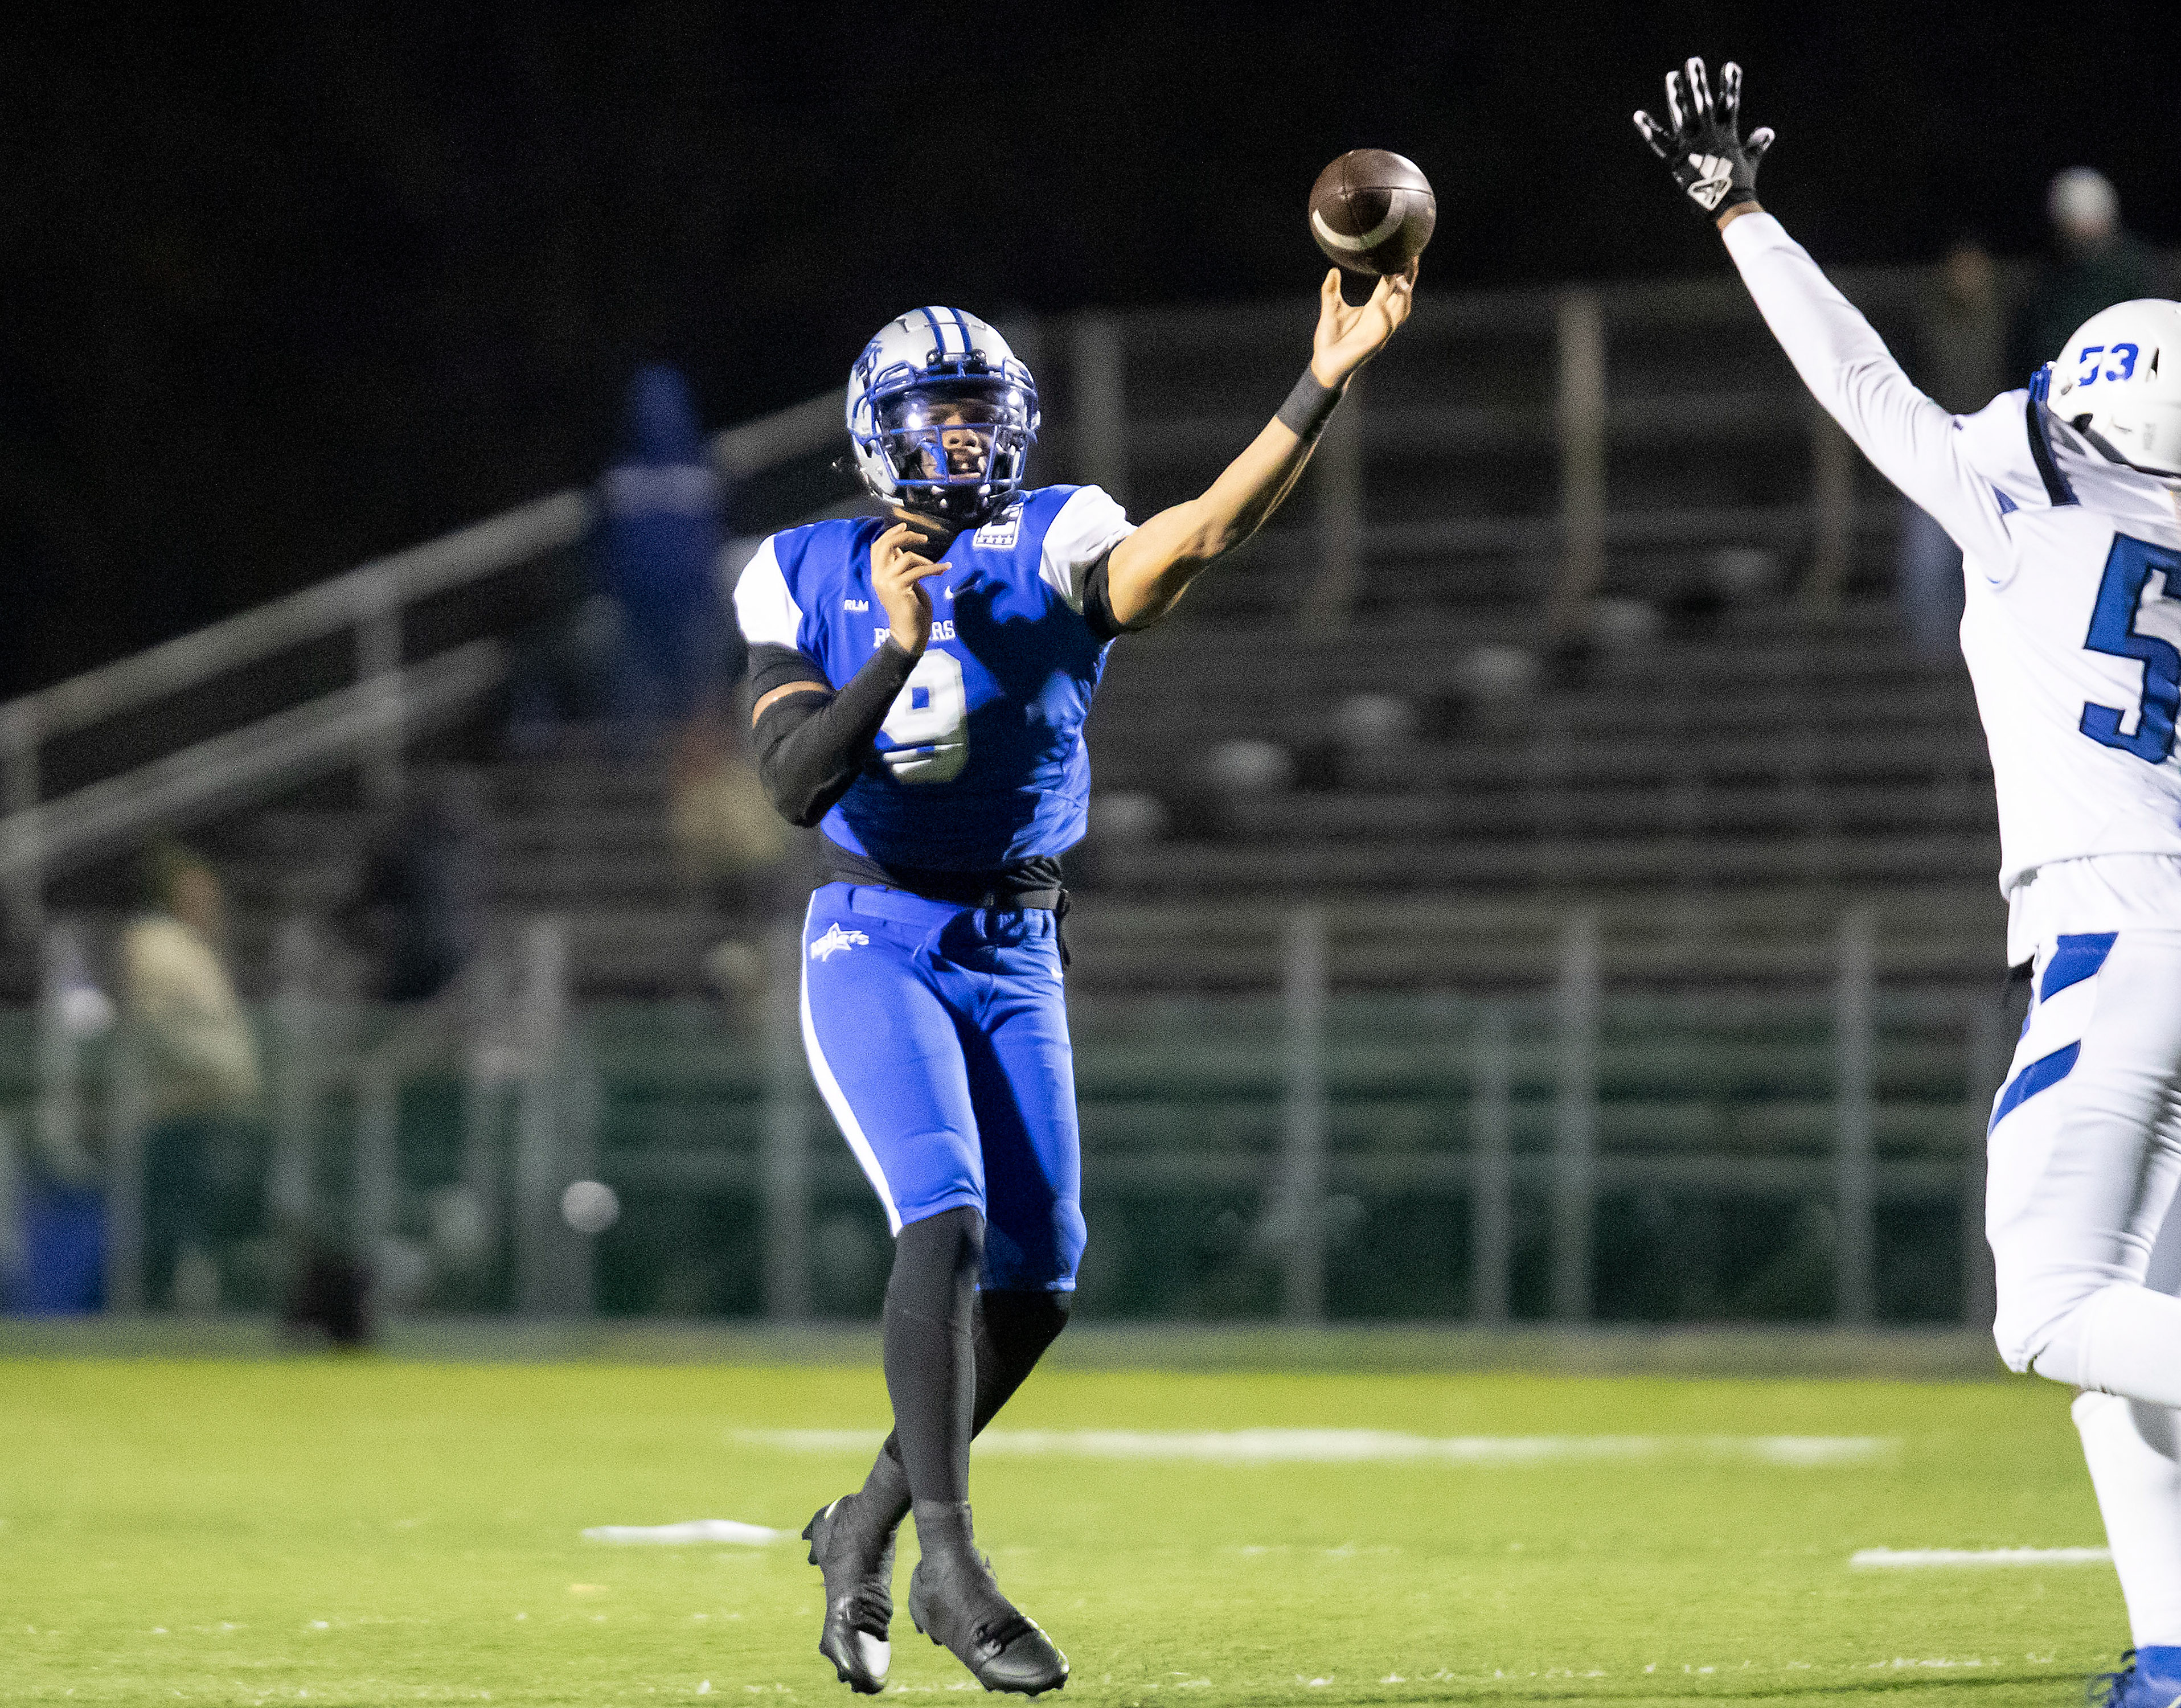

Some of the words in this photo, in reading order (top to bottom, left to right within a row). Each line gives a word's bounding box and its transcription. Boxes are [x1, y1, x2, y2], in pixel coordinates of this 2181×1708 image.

[2078, 342, 2138, 387] 53
[844, 599, 869, 611] RLM
[2079, 530, 2181, 765] 5
